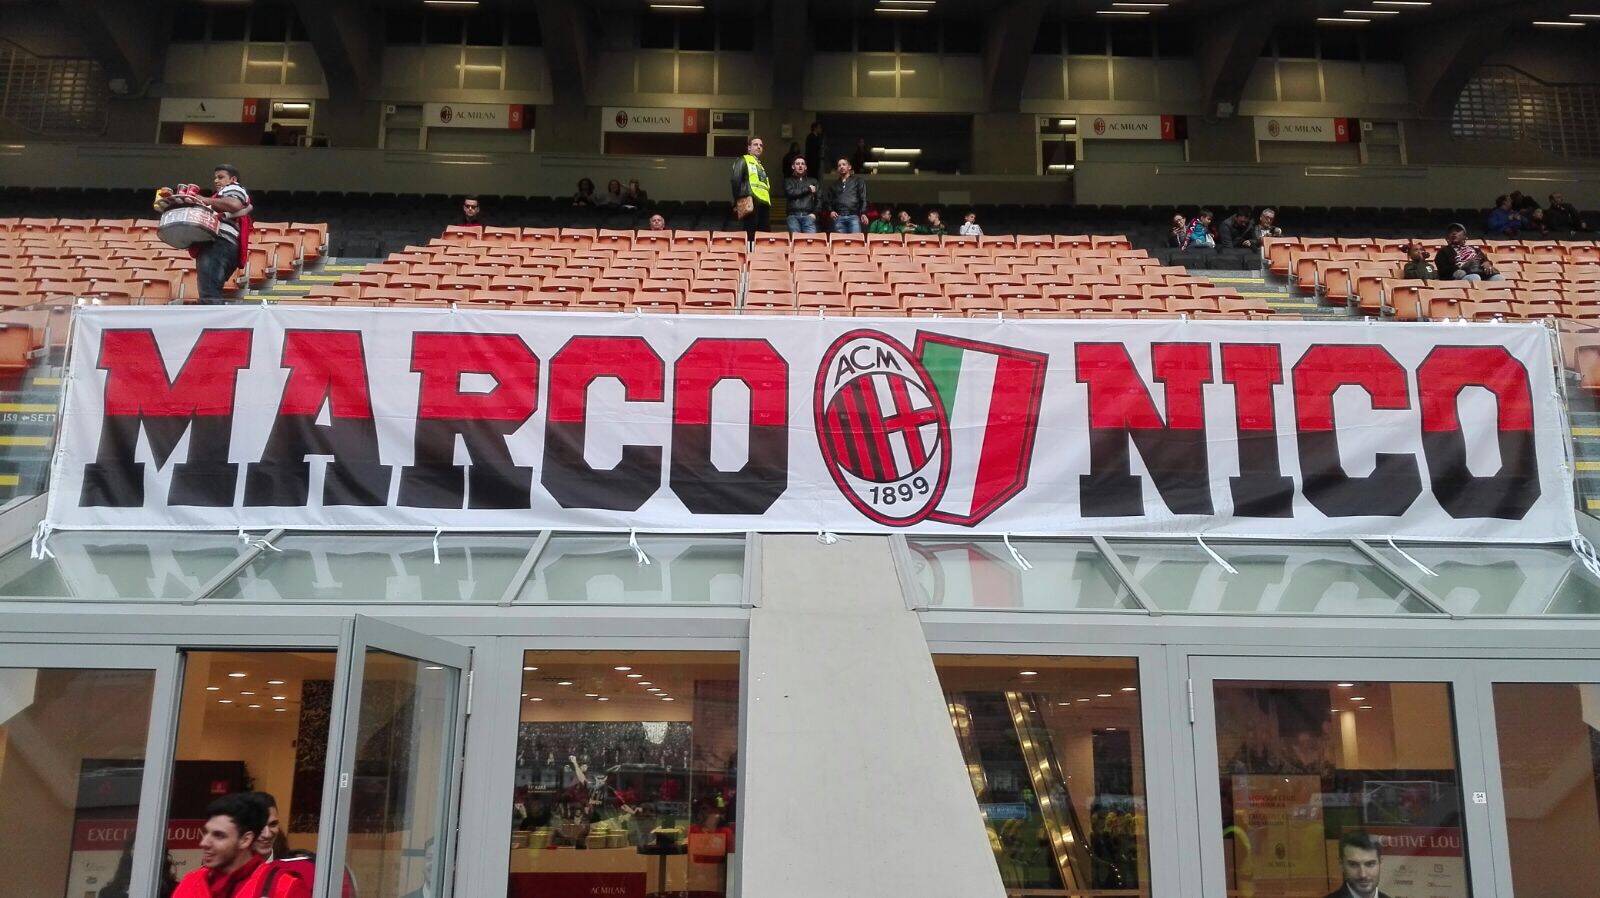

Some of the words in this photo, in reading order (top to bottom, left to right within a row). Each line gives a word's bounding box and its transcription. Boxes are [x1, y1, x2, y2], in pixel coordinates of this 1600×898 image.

[244, 104, 256, 116] 10
[468, 112, 496, 120] MILAN
[512, 111, 520, 122] 9
[643, 116, 671, 124] MILAN
[687, 115, 694, 126] 8
[1121, 123, 1149, 131] MILAN
[1164, 122, 1171, 132] 7
[1294, 125, 1323, 133] MILAN
[1338, 125, 1345, 135] 6
[834, 345, 903, 388] ACM
[78, 328, 790, 515] MARCO
[1074, 341, 1541, 520] NICO
[869, 476, 930, 506] 1899
[601, 887, 626, 895] MILAN
